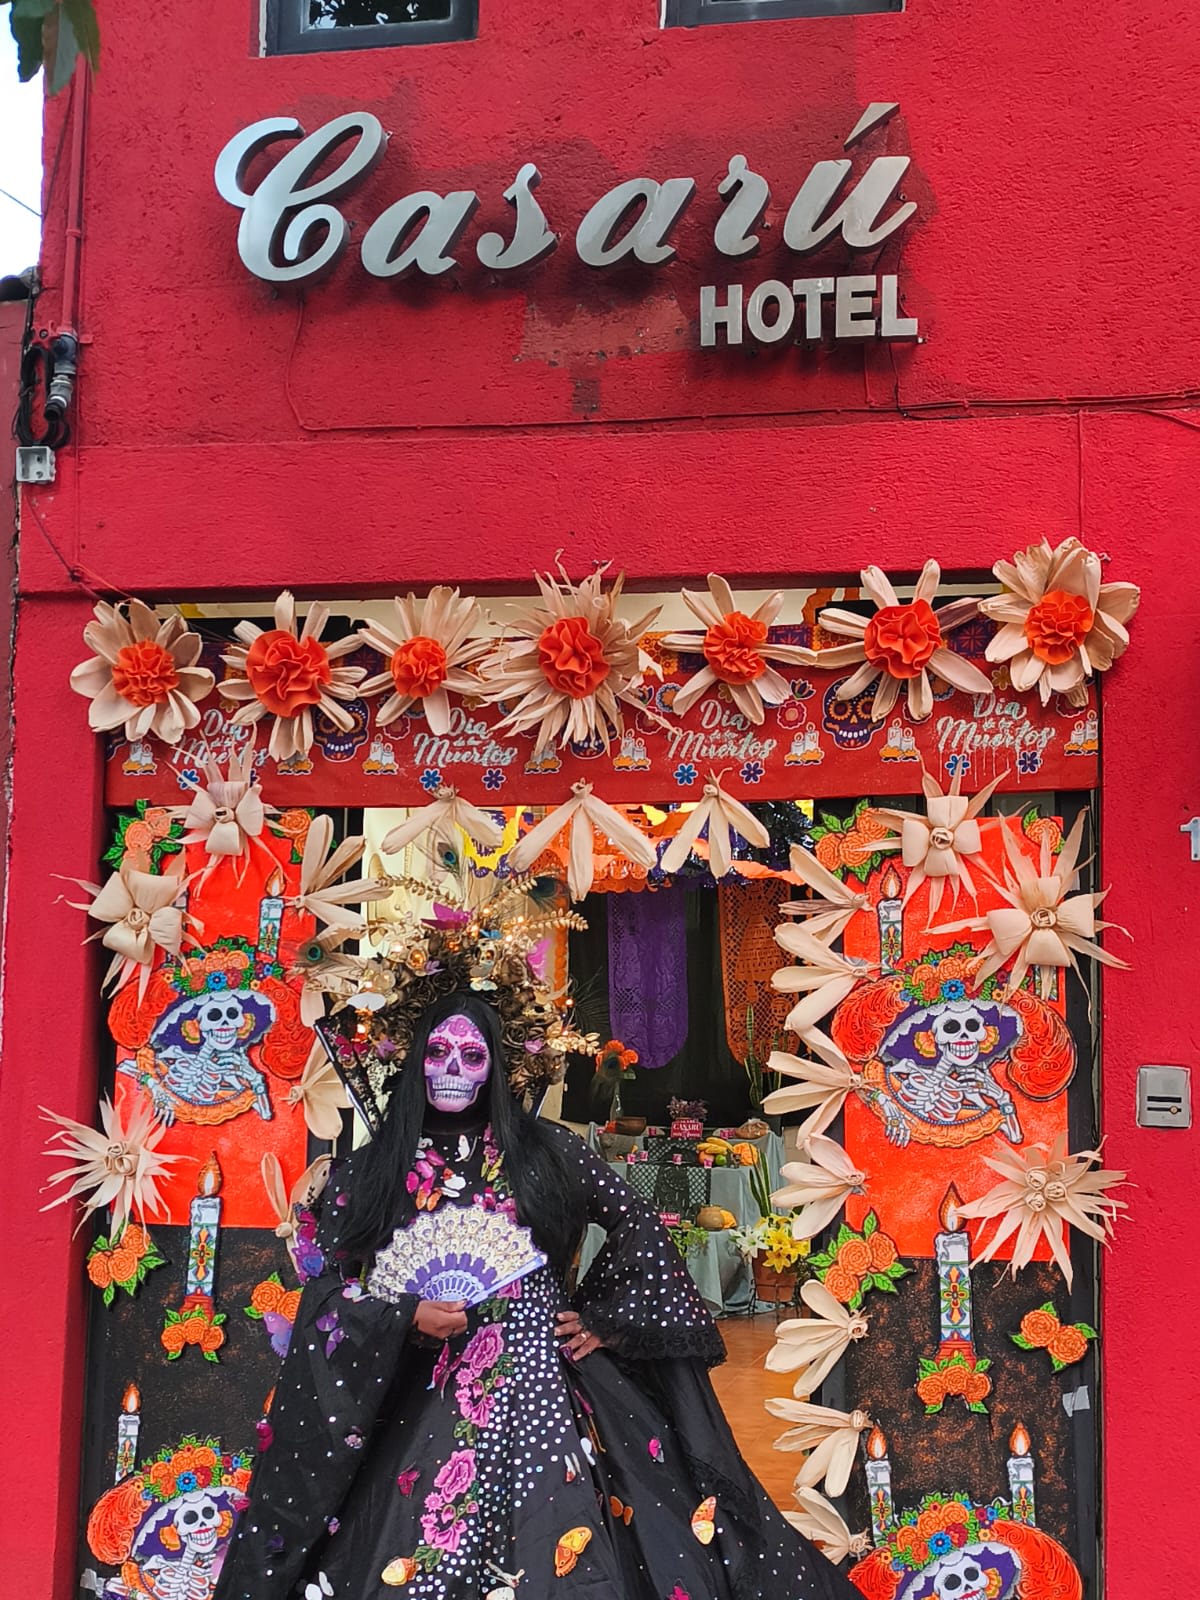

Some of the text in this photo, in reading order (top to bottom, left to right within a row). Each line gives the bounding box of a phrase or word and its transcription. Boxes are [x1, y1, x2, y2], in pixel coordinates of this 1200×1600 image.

[214, 102, 918, 281] Casarú
[700, 275, 919, 346] HOTEL
[700, 699, 751, 732] Dia
[413, 732, 519, 768] Muertos
[666, 726, 778, 763] Muertos
[936, 716, 1056, 754] Muertos
